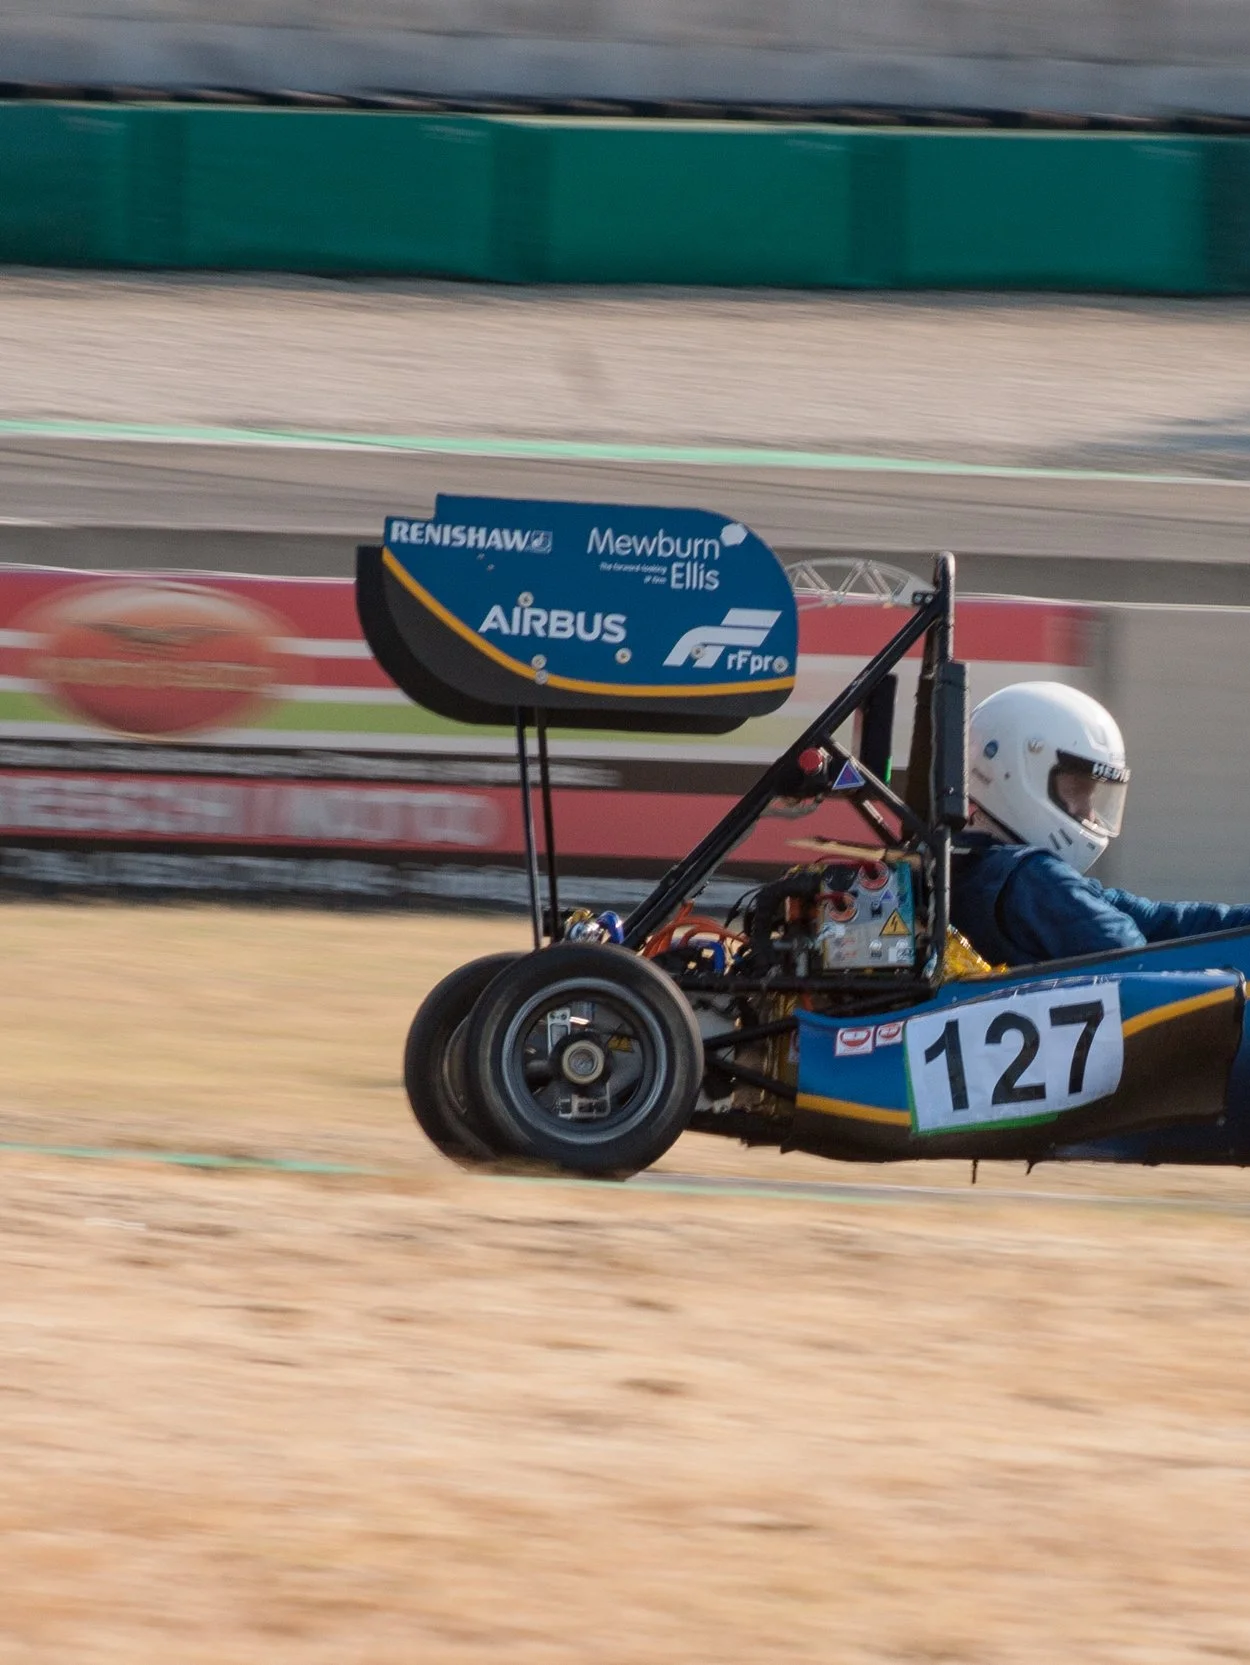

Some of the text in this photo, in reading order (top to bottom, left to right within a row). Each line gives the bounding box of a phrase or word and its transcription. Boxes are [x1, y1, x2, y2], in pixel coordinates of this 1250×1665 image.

[390, 519, 532, 553] RENISHAW
[586, 526, 720, 560] Mewburn
[670, 560, 720, 591] Ellis
[477, 604, 627, 644] AIRBUS
[726, 648, 780, 676] rFpr
[924, 1000, 1105, 1111] 127
